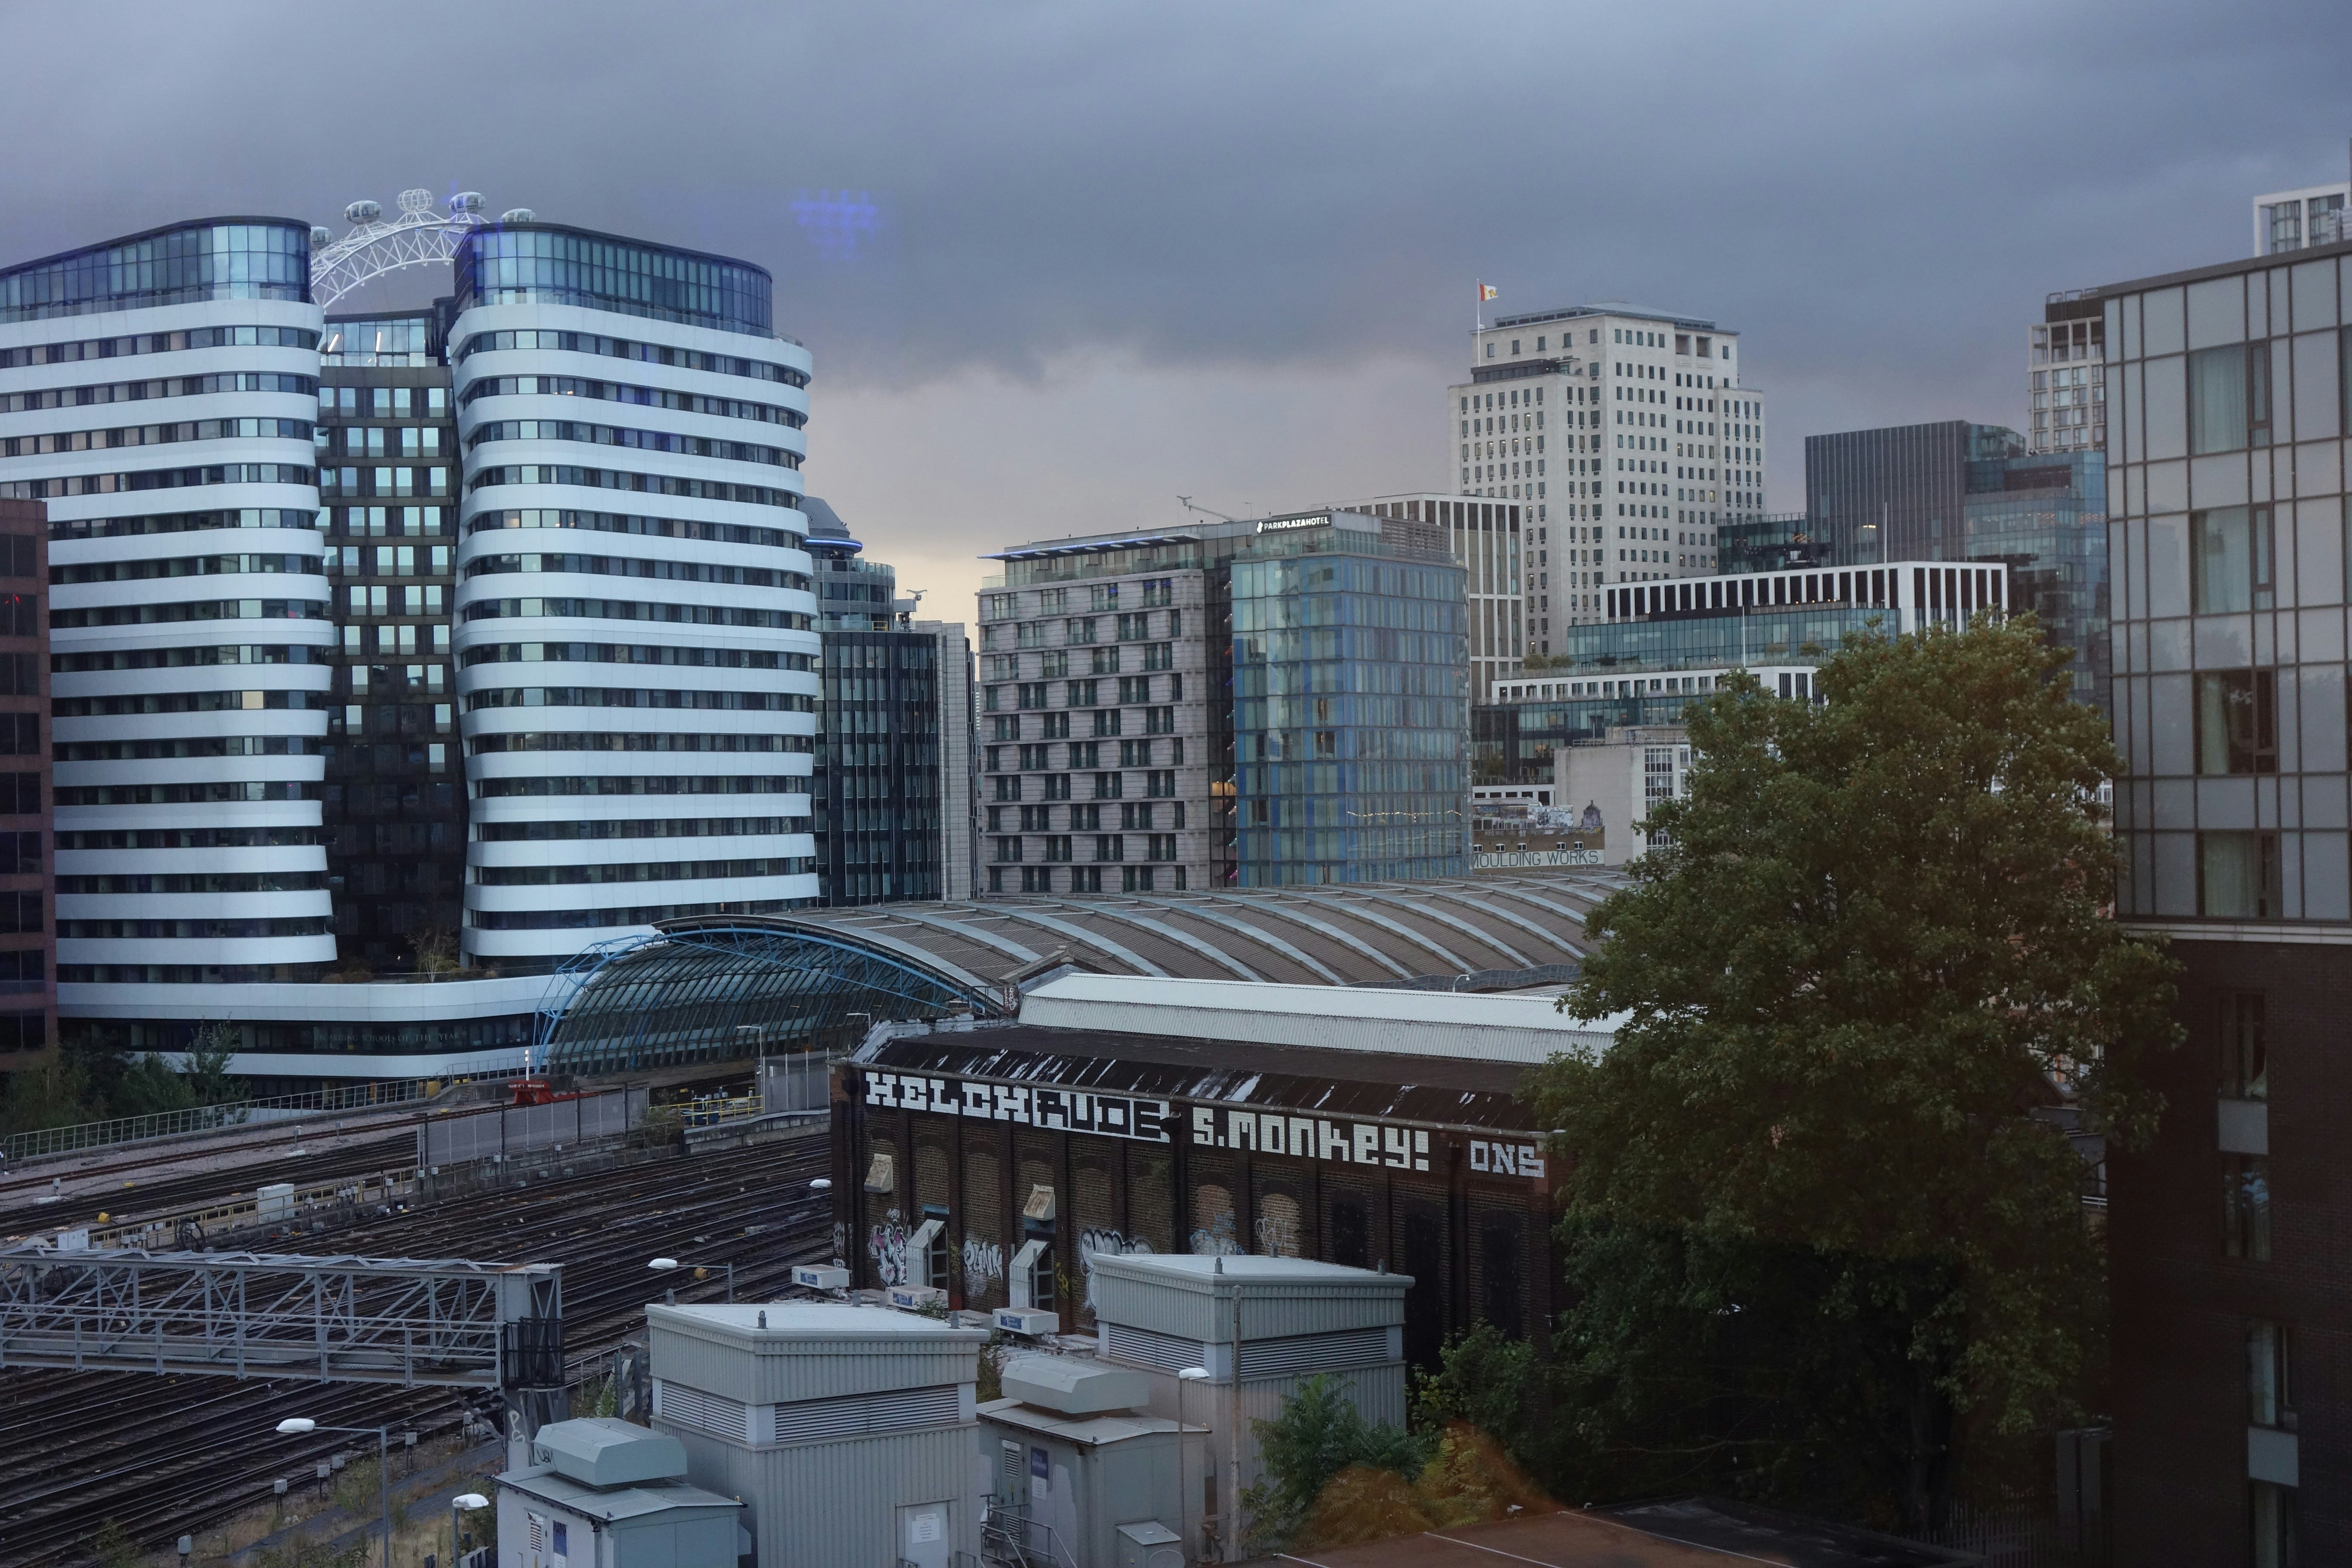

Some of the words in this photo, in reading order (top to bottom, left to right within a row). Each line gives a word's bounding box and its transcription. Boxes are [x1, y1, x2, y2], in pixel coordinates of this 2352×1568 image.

[1547, 850, 1599, 865] WORKS
[398, 1034, 409, 1042] OF
[415, 1033, 432, 1041] THE
[438, 1032, 459, 1041] YEAR
[865, 1072, 1029, 1123] HELCH
[1470, 1140, 1545, 1178] ONS
